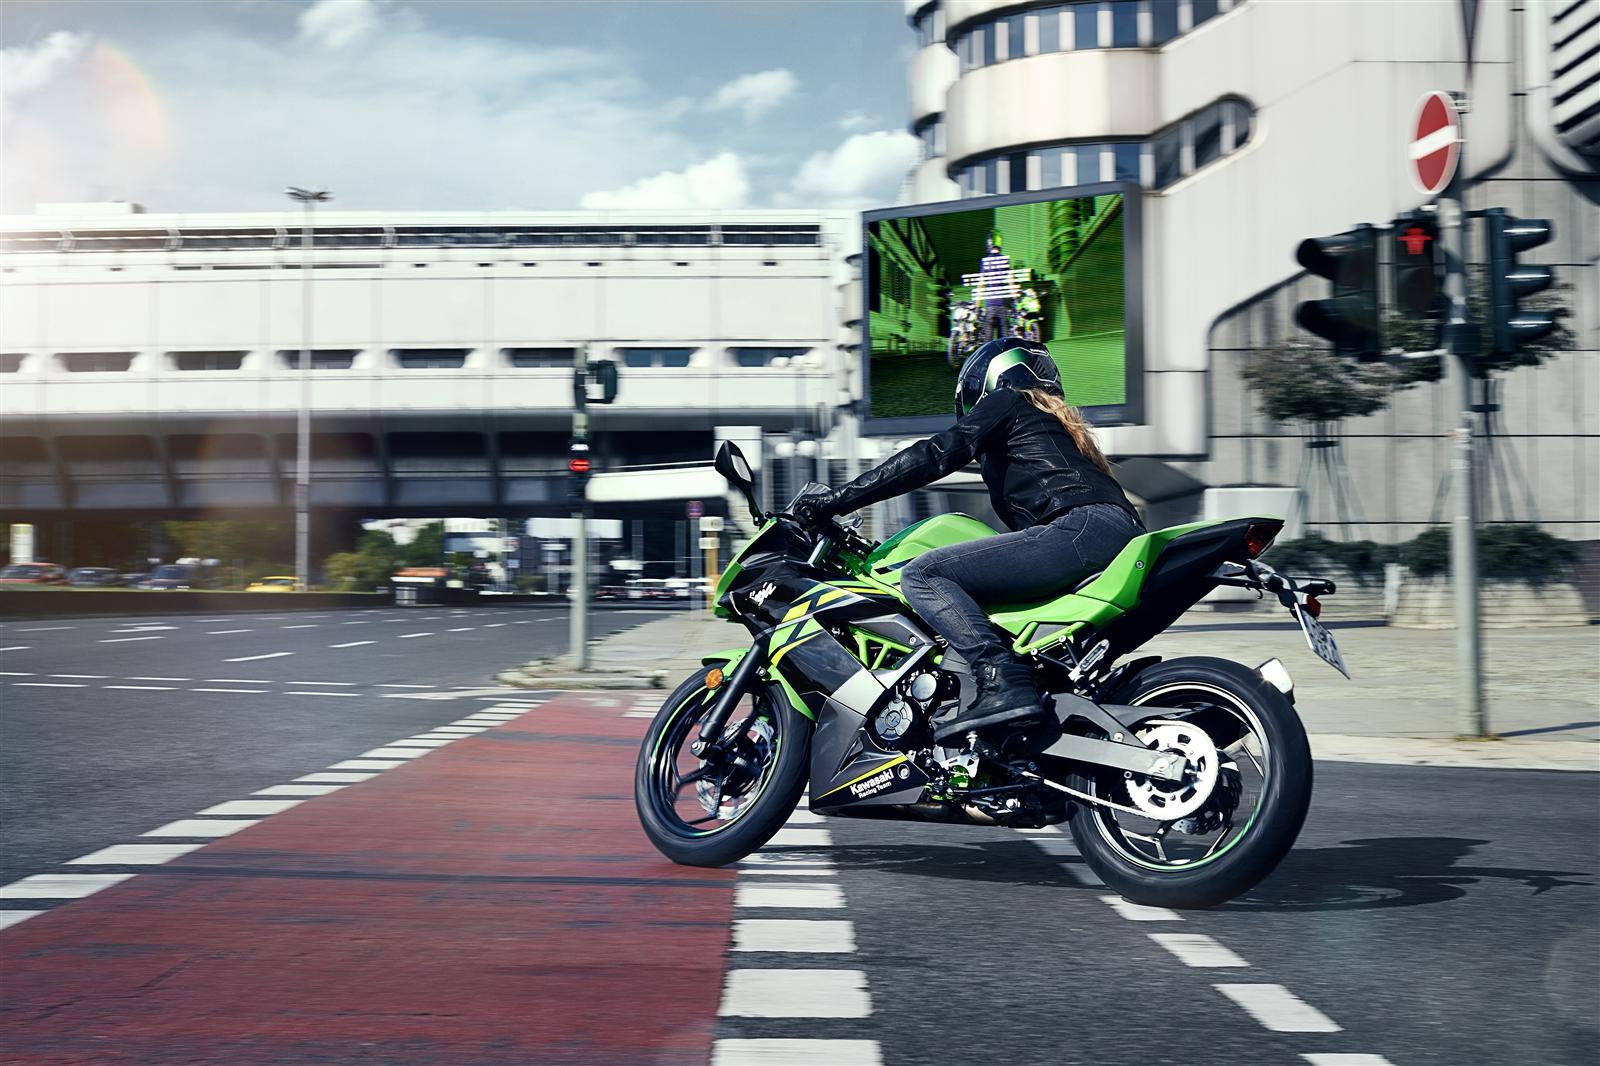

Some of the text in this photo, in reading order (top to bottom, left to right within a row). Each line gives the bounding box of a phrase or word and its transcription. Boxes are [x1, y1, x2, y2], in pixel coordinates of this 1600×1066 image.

[850, 768, 894, 795] Kawasaki
[858, 781, 892, 798] Racing Team
